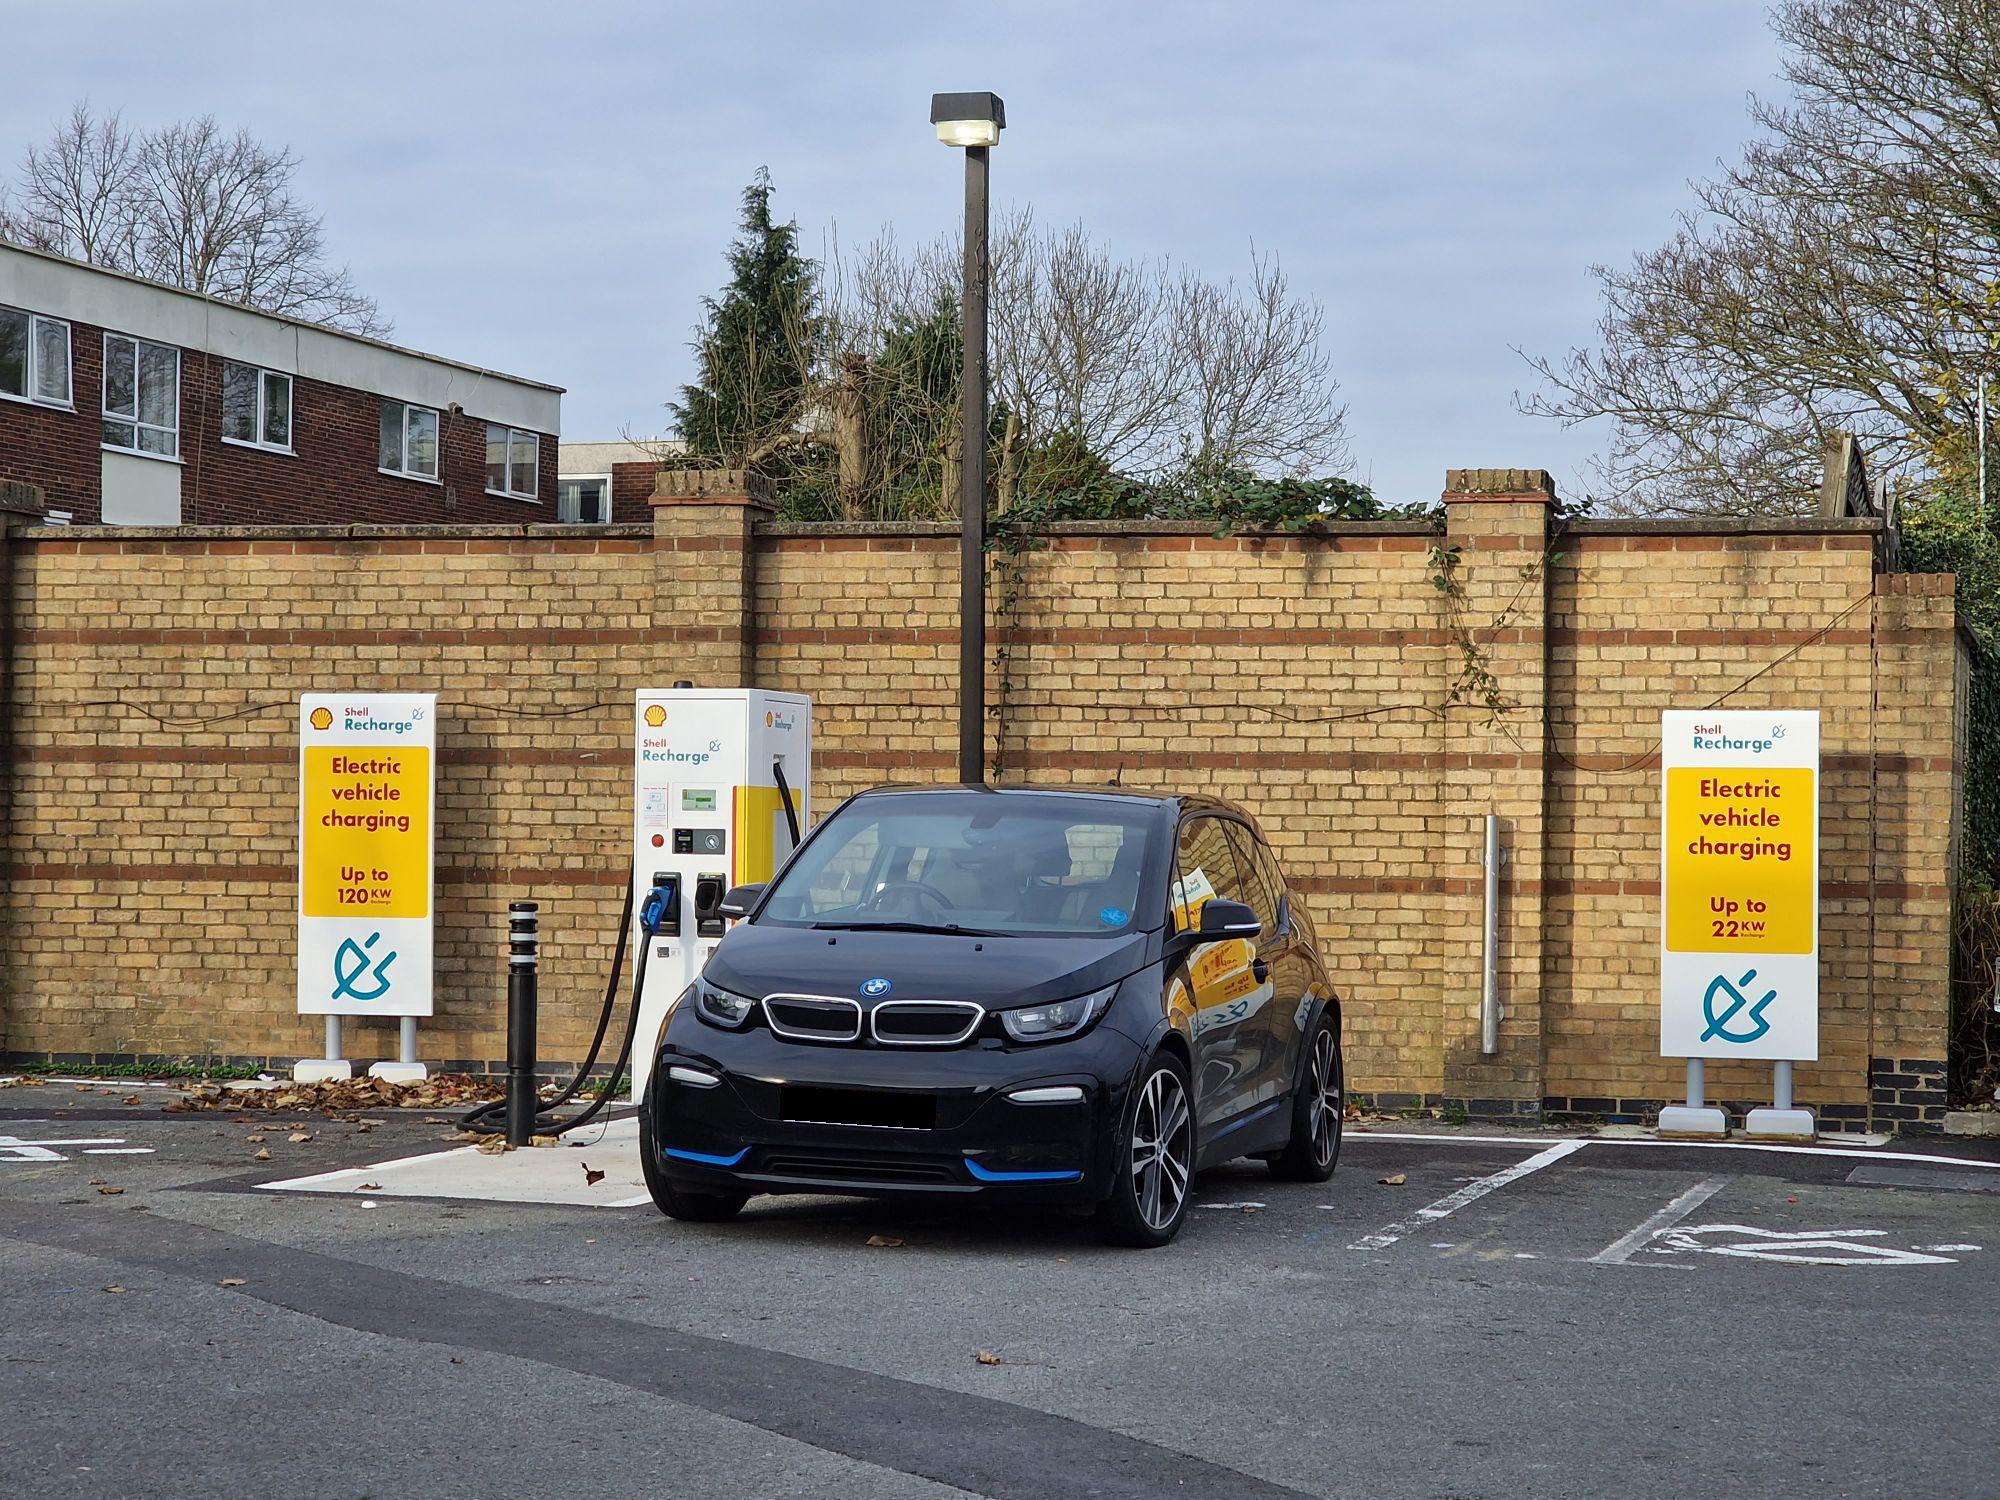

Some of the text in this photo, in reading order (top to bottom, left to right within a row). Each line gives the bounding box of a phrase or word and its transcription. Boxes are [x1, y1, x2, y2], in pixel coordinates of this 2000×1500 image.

[345, 706, 369, 717] Shell
[345, 717, 413, 735] Recharge
[1694, 724, 1722, 735] Shell
[643, 738, 667, 748] Shell
[1694, 735, 1773, 754] Recharge
[332, 755, 401, 775] Electric
[643, 748, 710, 766] Recharge
[332, 782, 401, 801] vehicle
[1700, 778, 1781, 798] Electric
[321, 808, 410, 833] charging
[1699, 807, 1781, 827] vehicle
[1688, 835, 1791, 862] charging
[341, 866, 389, 885] Up to
[337, 887, 391, 904] 120 KW
[1710, 896, 1767, 918] Up to
[1711, 919, 1766, 938] 22 KW
